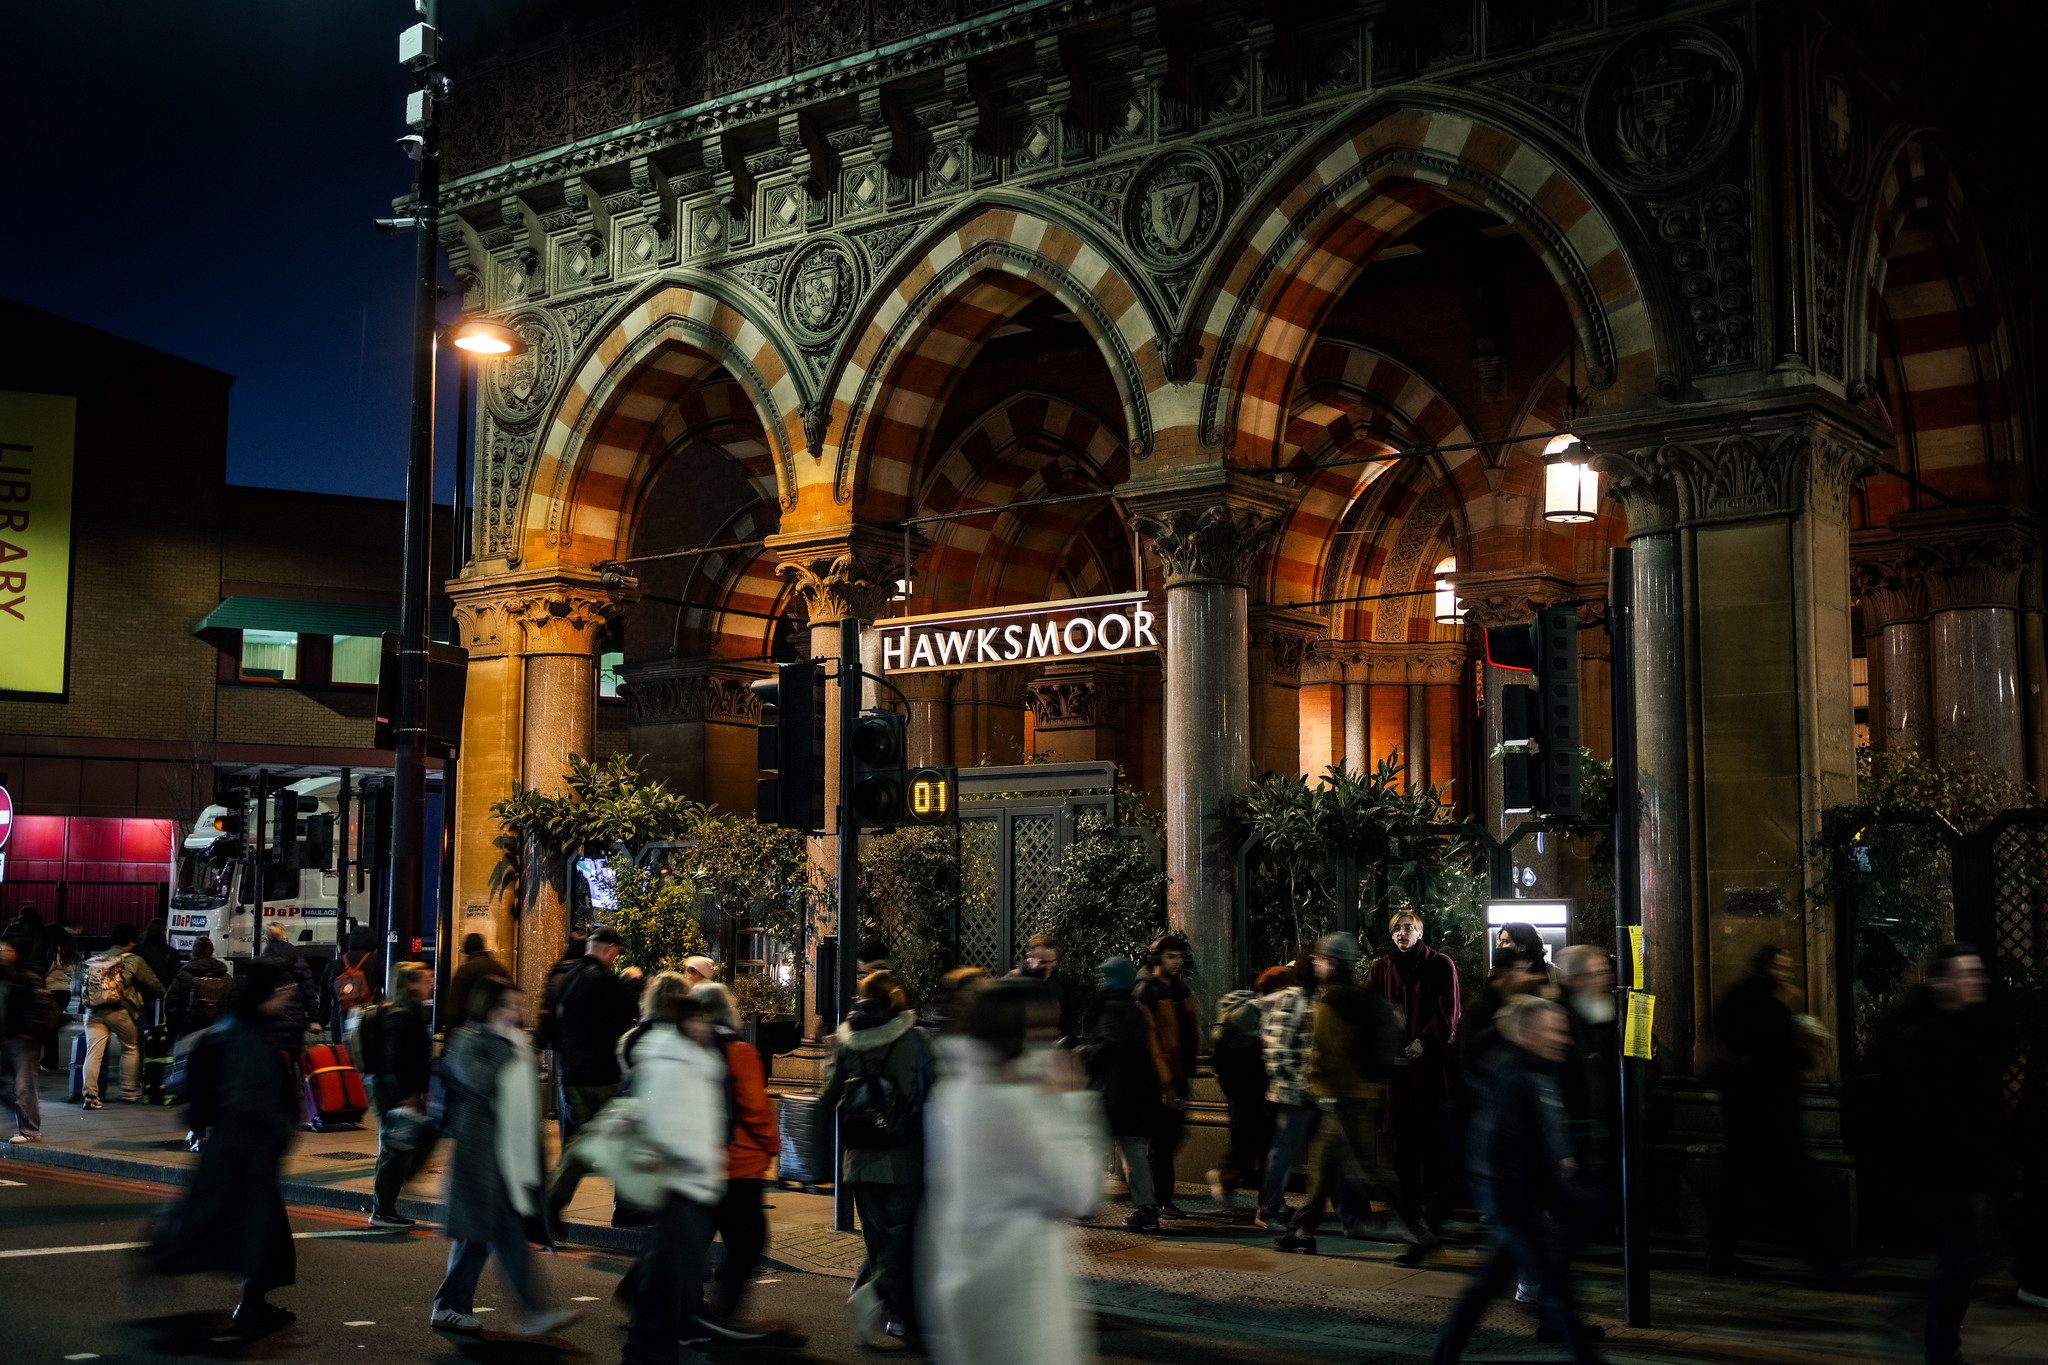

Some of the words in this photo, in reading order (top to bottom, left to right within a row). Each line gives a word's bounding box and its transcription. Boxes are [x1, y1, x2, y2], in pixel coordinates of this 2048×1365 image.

[0, 443, 33, 621] LIBRARY
[884, 611, 1158, 669] HAWKSMOOR
[915, 781, 945, 812] 01
